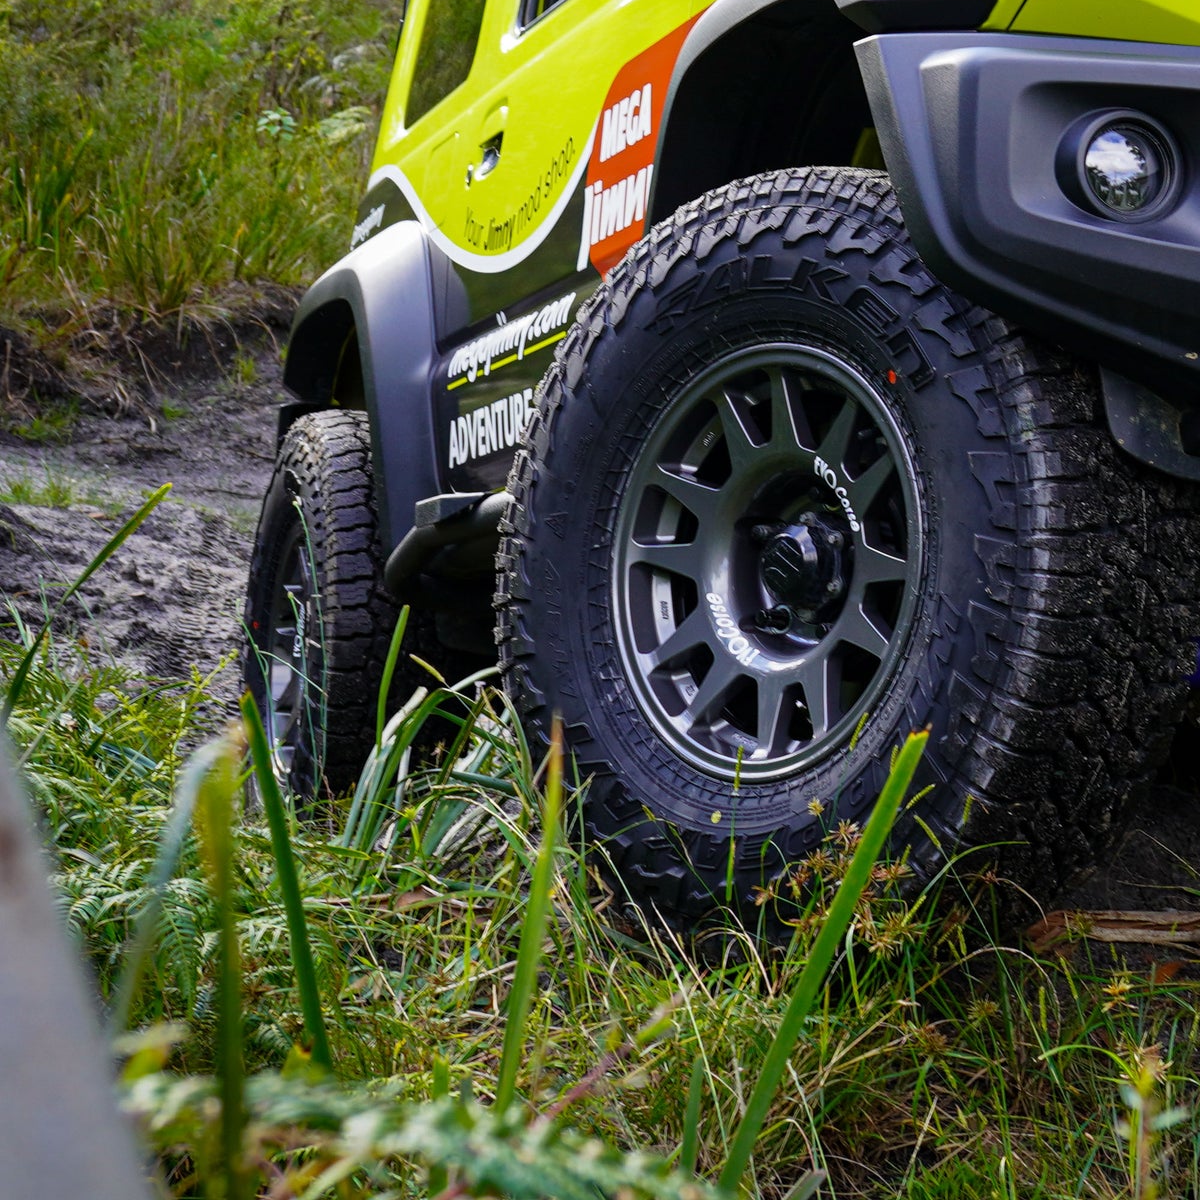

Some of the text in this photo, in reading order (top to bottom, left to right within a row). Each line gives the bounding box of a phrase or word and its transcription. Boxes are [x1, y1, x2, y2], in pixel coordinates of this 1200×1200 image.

[600, 83, 652, 163] MEGA
[464, 207, 484, 248] Your
[517, 176, 542, 234] mod
